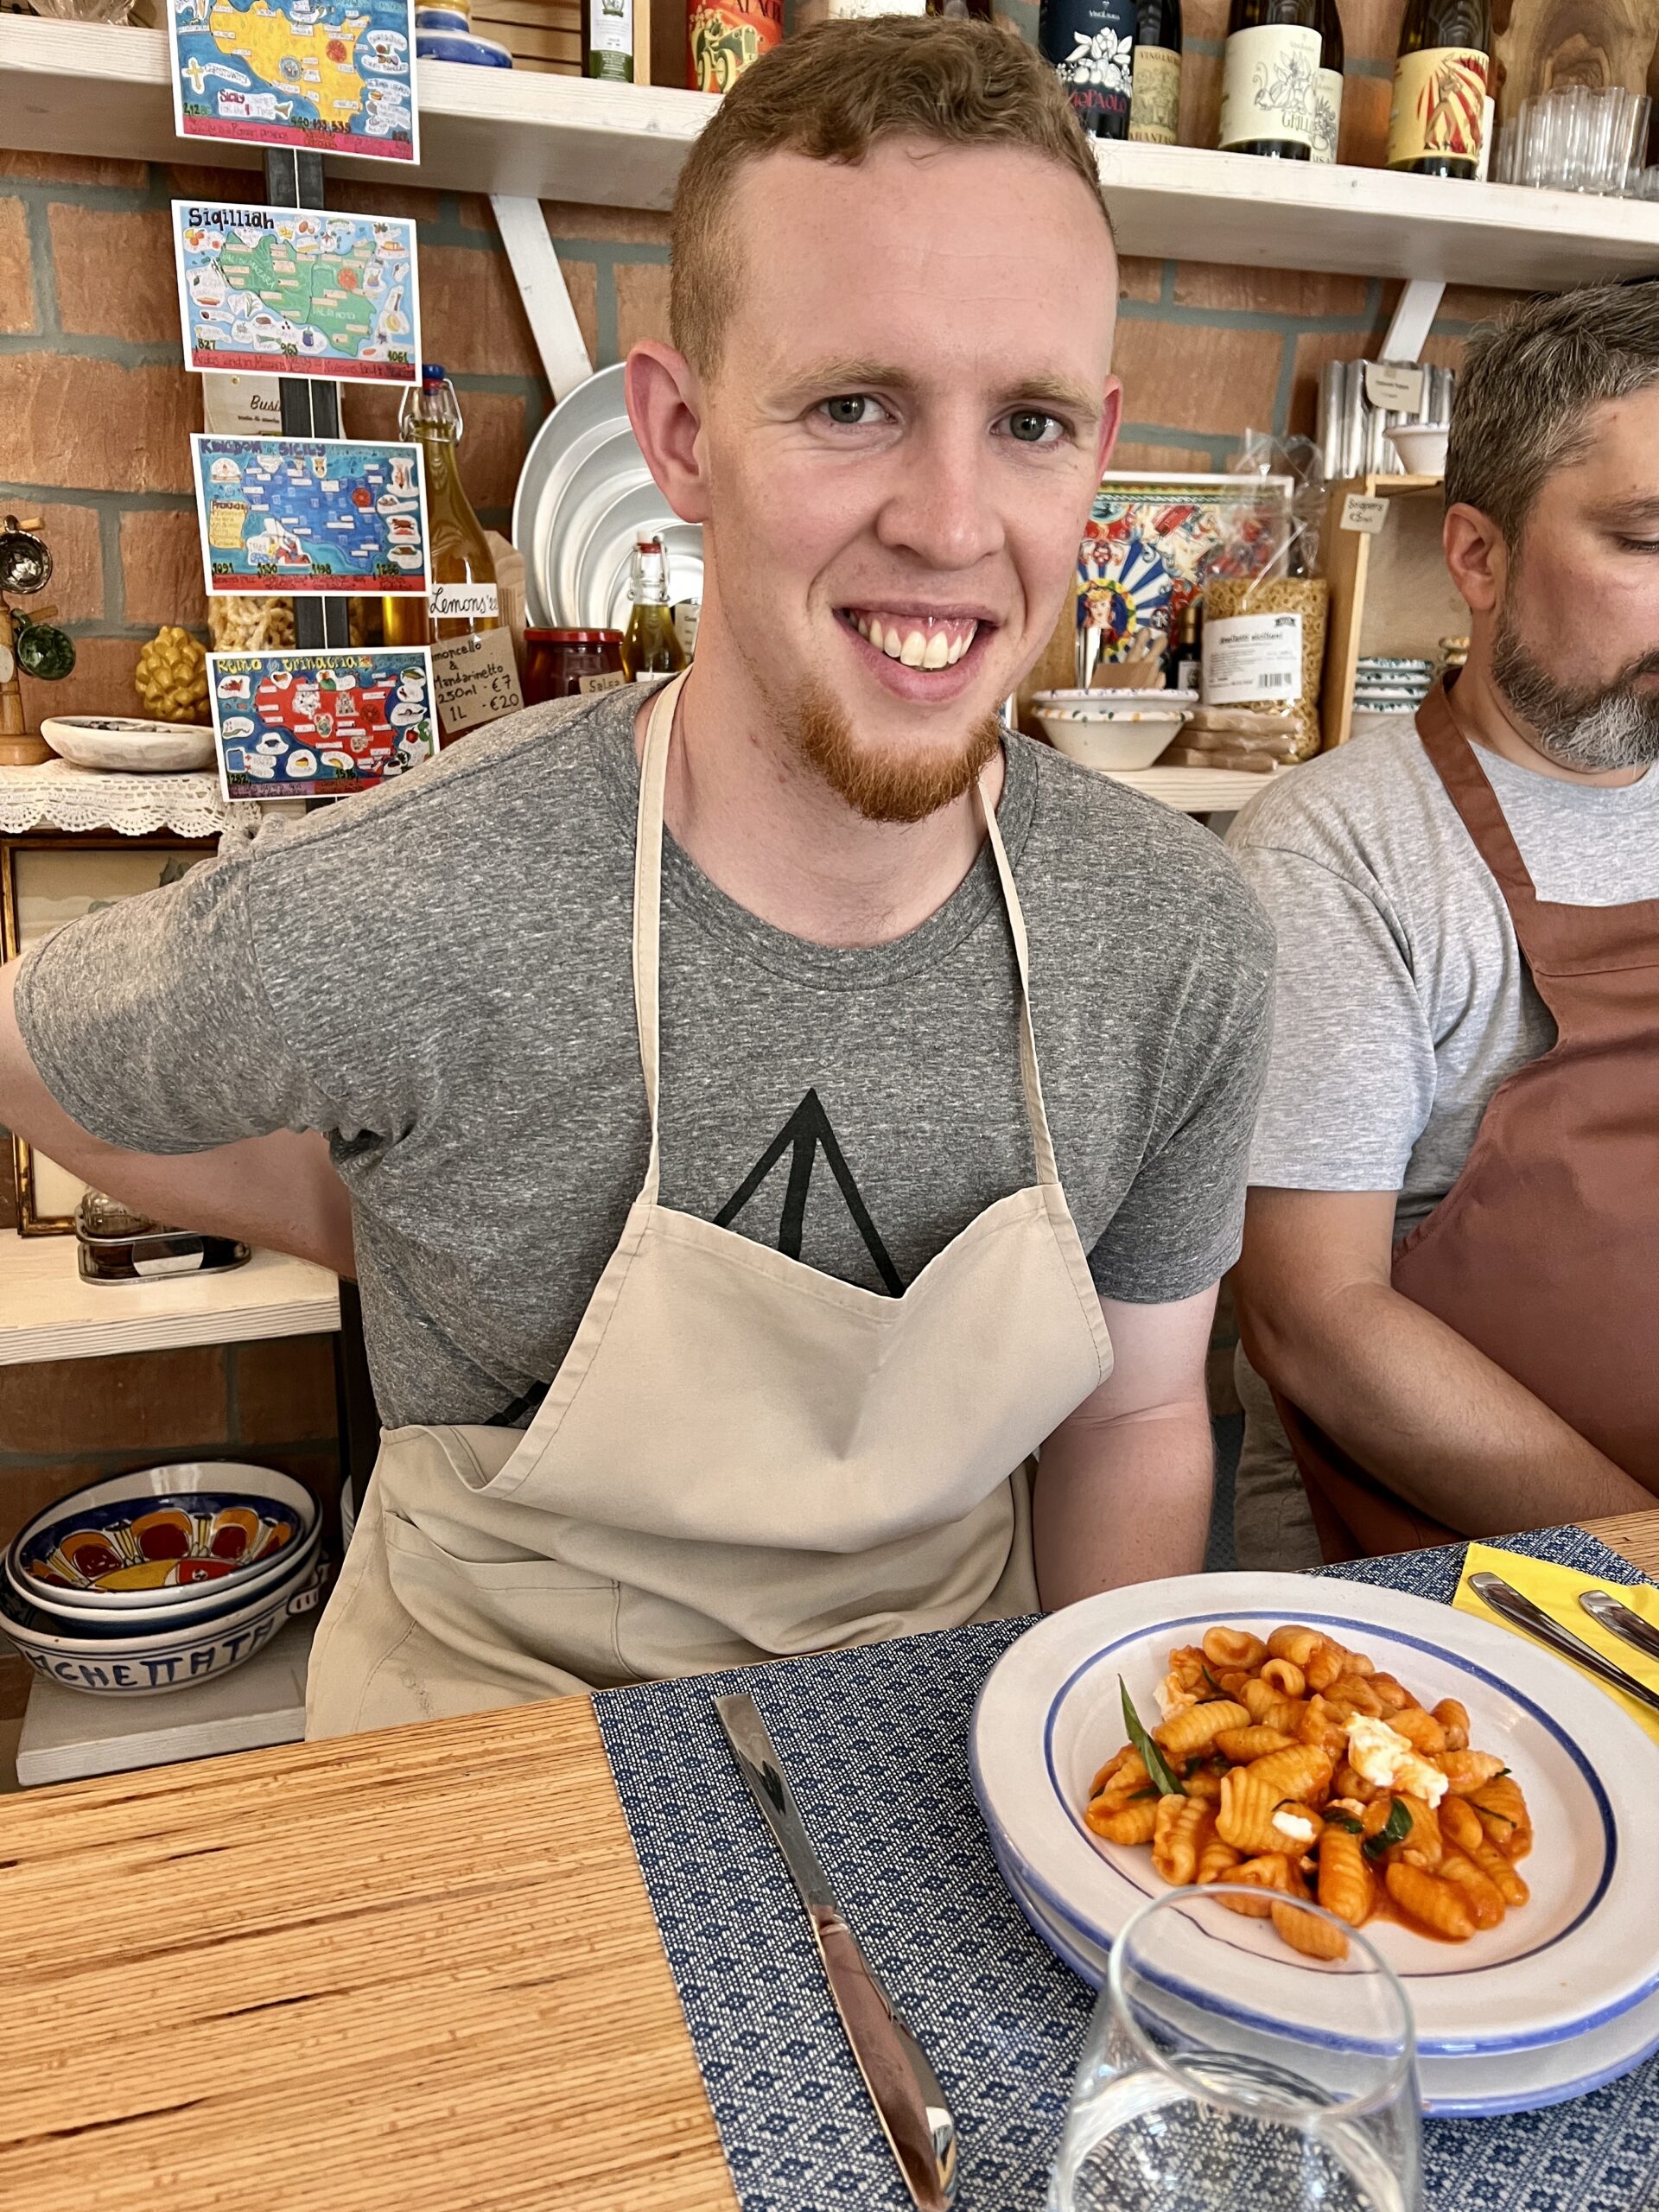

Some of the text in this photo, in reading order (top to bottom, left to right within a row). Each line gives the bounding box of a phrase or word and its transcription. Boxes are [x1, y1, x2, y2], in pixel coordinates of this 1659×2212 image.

[188, 207, 275, 232] Siqilliah
[200, 438, 263, 455] KINGDOM
[278, 441, 327, 457] SICILY
[449, 660, 459, 671] &
